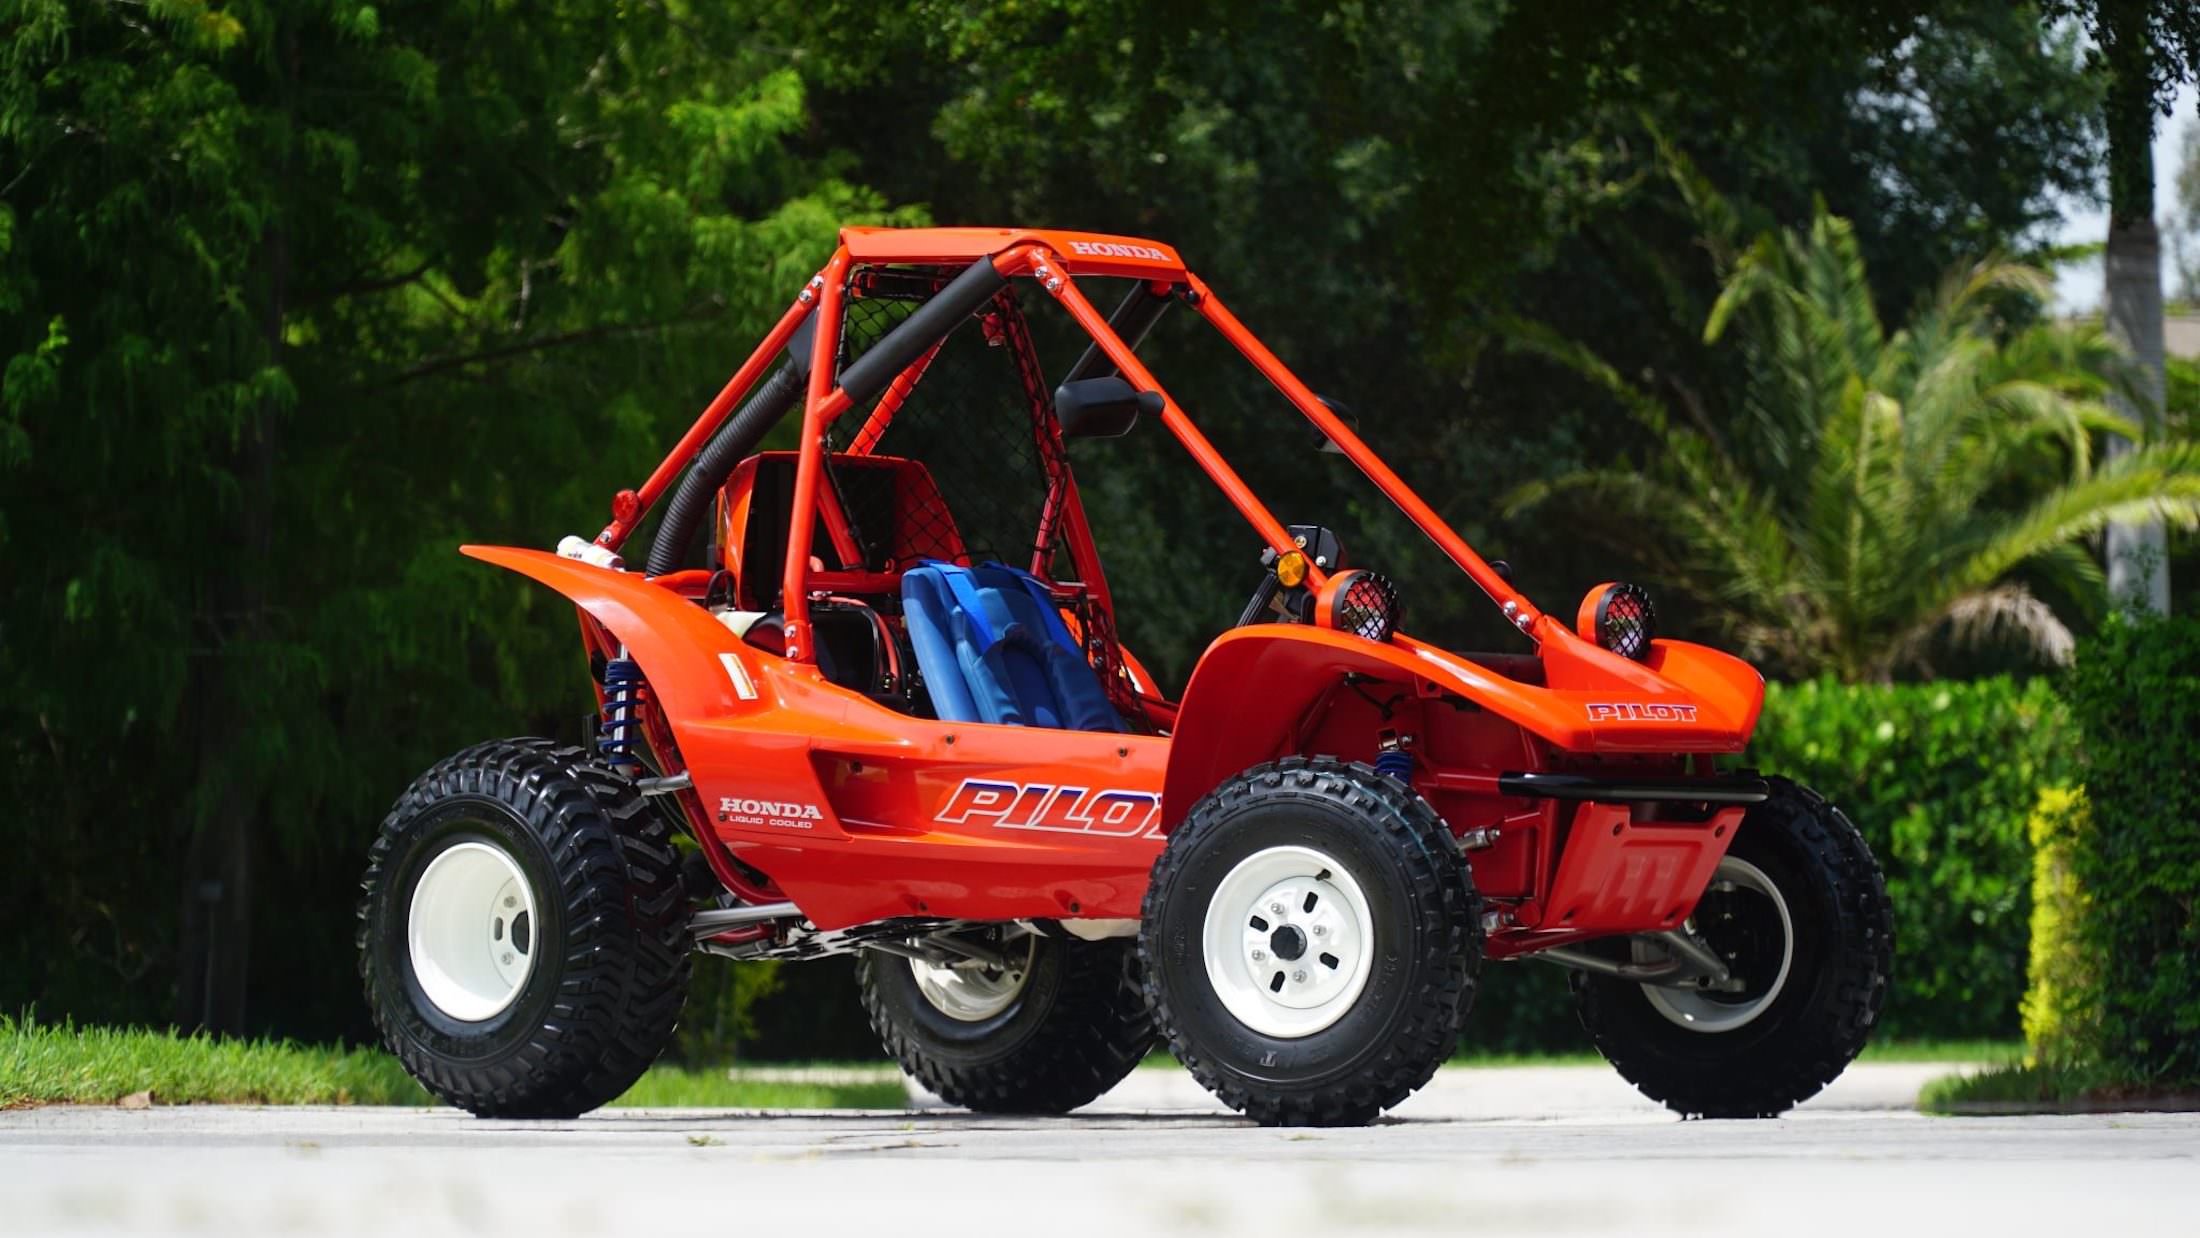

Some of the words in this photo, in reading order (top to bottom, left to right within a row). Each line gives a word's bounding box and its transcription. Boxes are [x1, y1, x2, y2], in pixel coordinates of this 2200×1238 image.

[1068, 241, 1172, 262] HONDA
[1585, 703, 1697, 722] PILOT
[720, 797, 824, 820] HONDA
[729, 815, 764, 825] LIQUID
[769, 818, 812, 829] COOLED
